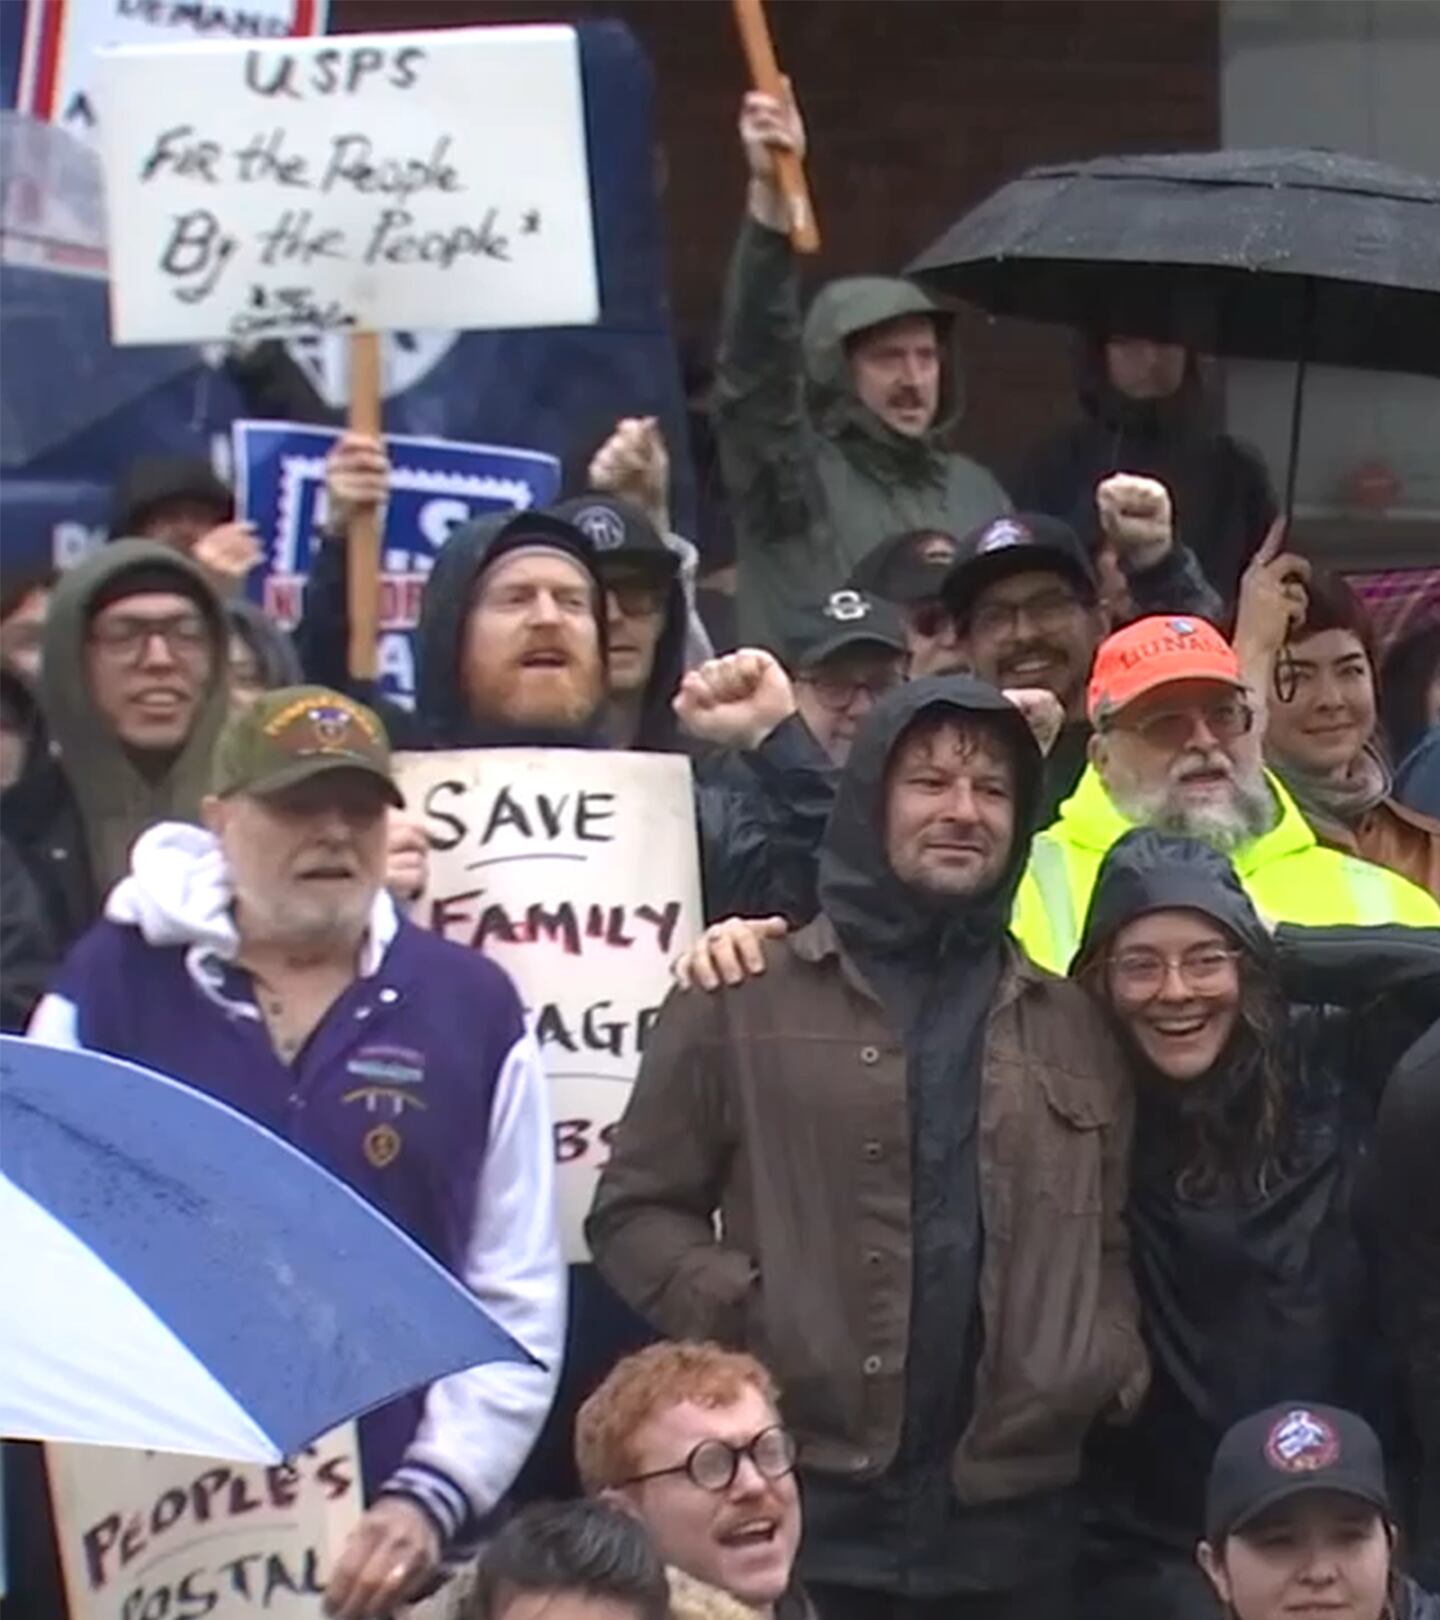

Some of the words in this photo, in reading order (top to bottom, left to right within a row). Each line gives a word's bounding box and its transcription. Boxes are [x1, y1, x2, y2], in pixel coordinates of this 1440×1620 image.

[244, 46, 430, 100] USPS
[233, 126, 313, 189] the
[319, 132, 468, 203] People
[160, 208, 240, 304] By
[256, 209, 349, 265] the
[424, 780, 616, 851] SAVE
[431, 888, 681, 955] FAMILY
